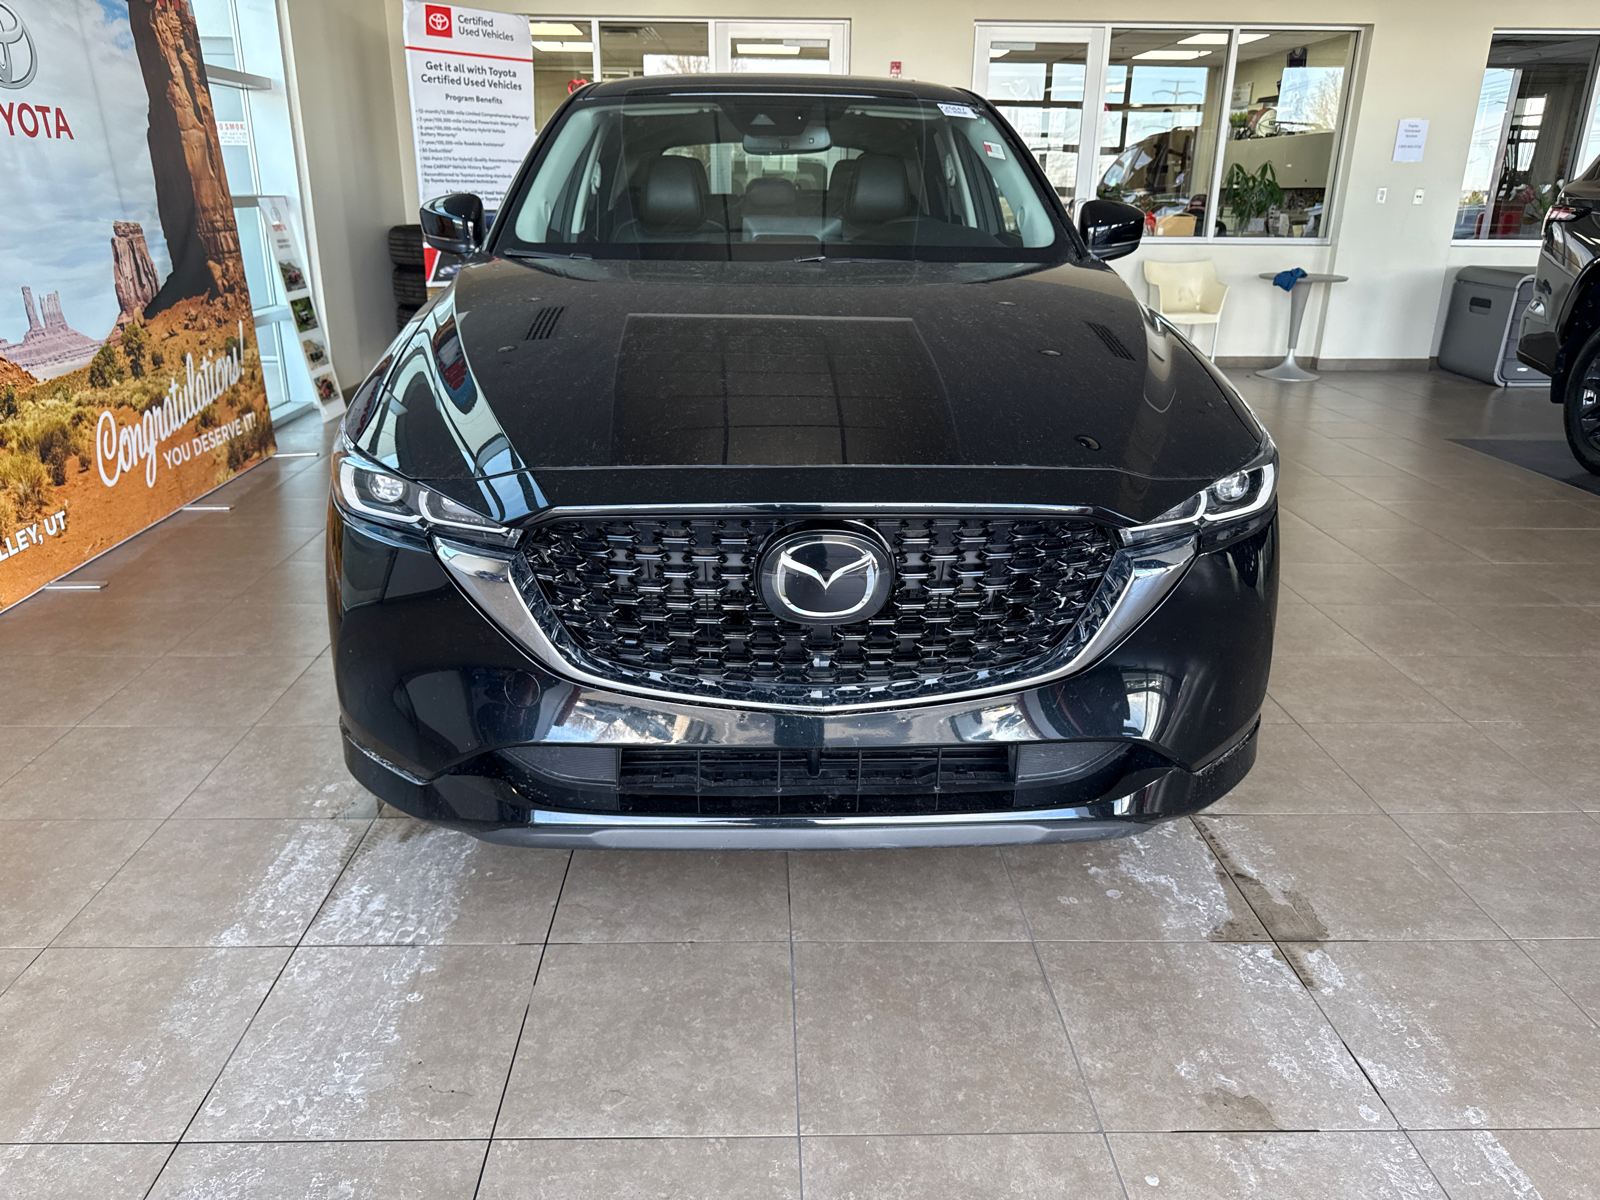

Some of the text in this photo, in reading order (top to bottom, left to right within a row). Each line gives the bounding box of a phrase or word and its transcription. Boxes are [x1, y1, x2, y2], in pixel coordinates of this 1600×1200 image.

[458, 15, 494, 28] Certified
[459, 27, 514, 41] Used Vehicles
[426, 61, 516, 78] Get it all with Toyota
[421, 74, 522, 90] Certified Used Vehicles
[445, 93, 502, 104] Program Benefits
[482, 112, 511, 120] Comprehensive
[96, 320, 244, 488] Congratulations!
[163, 412, 256, 470] YOU DESERVE IT!
[43, 510, 66, 536] UT
